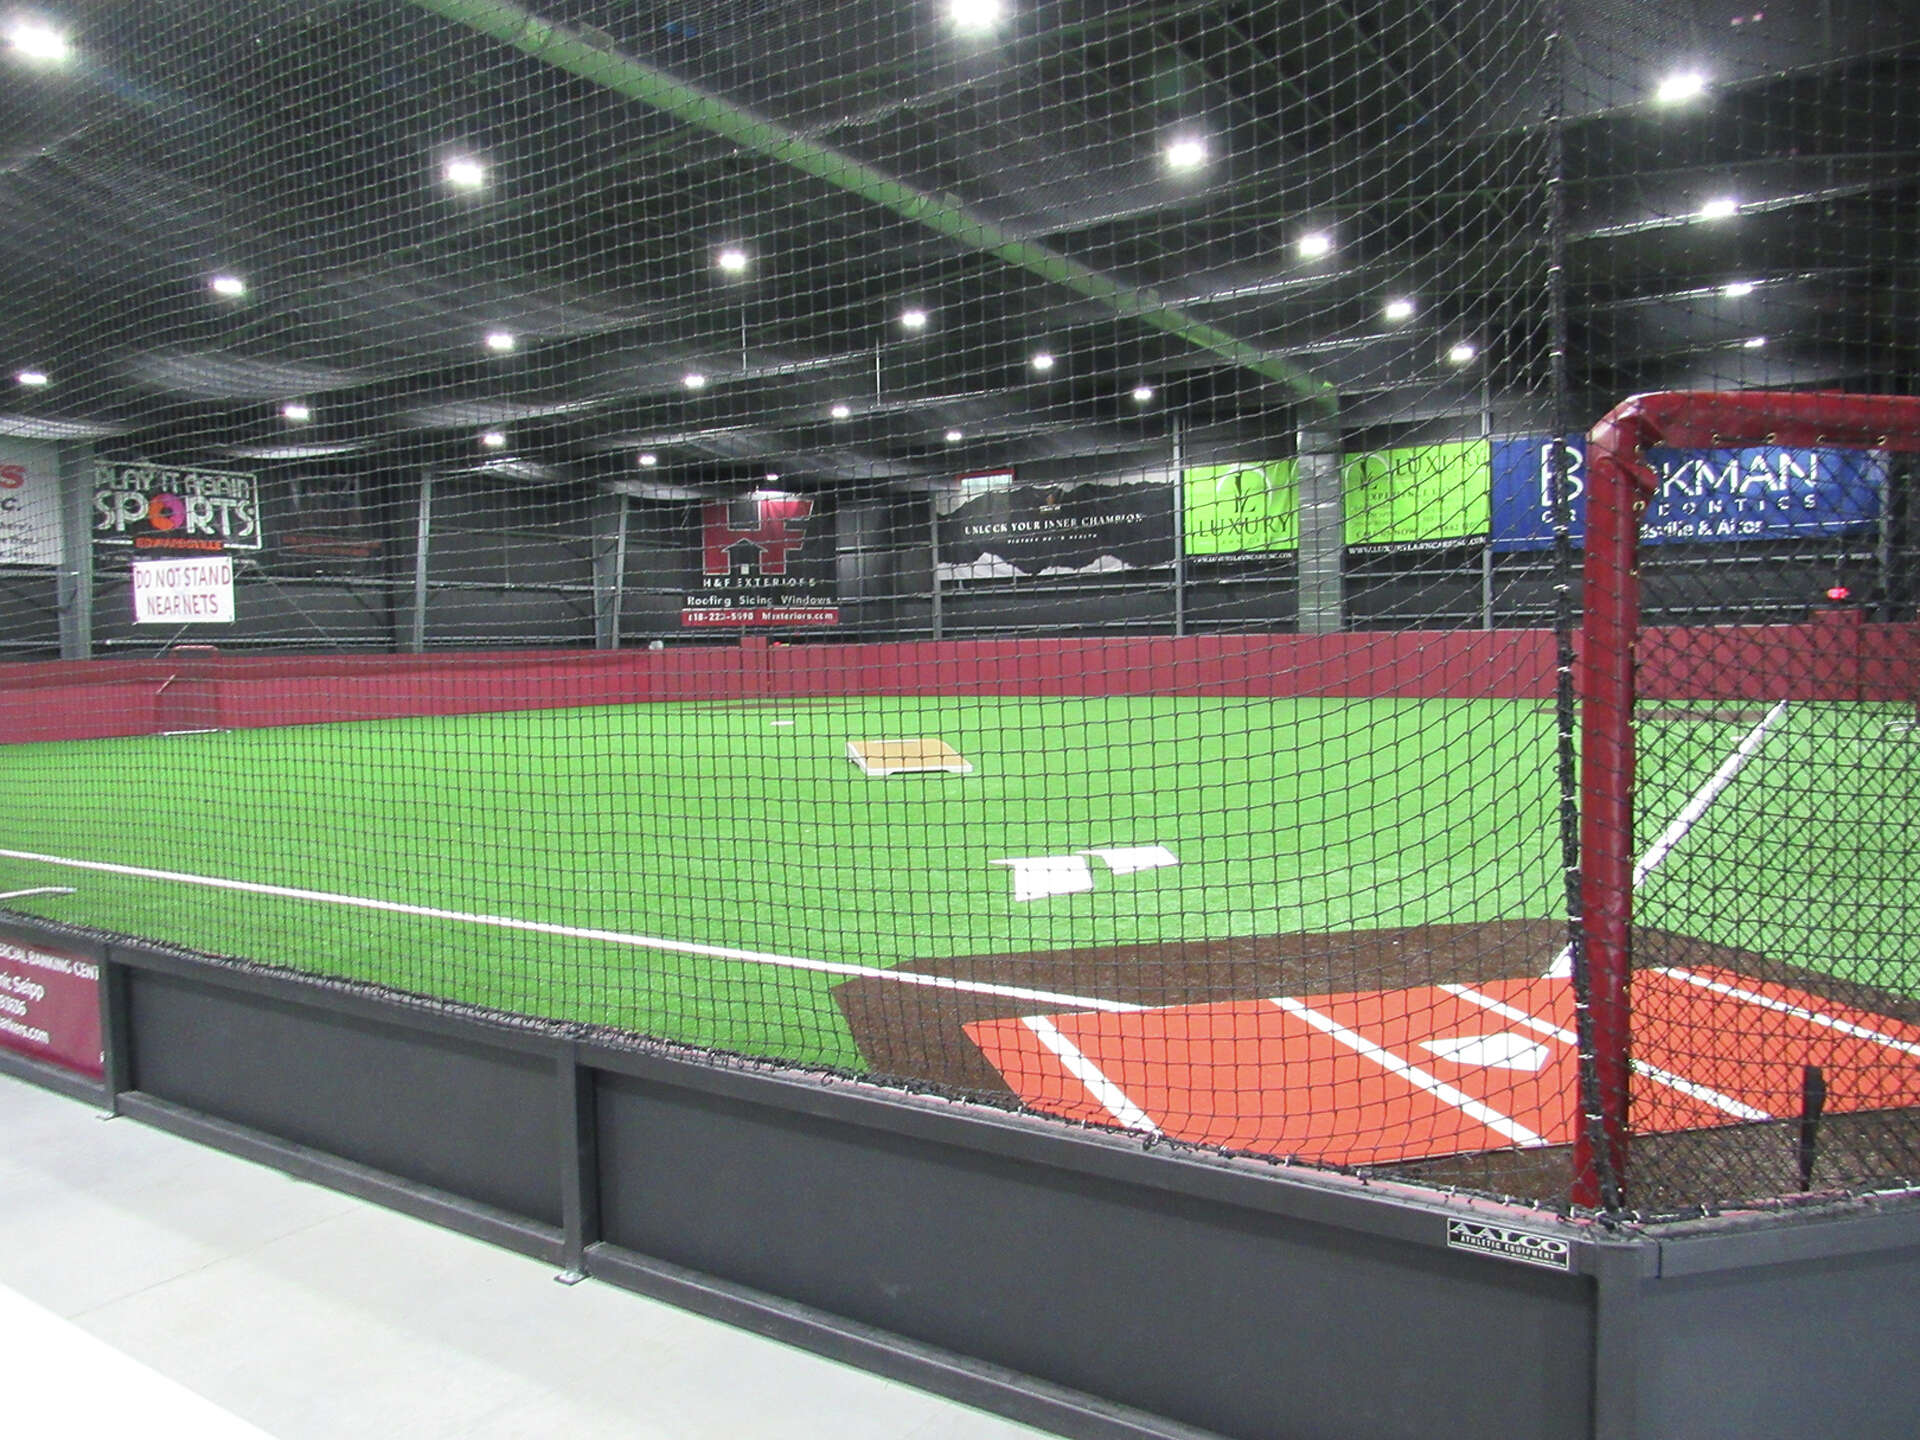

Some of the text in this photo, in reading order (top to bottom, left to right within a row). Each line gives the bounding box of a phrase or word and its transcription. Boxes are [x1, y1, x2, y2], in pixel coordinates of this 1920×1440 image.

[95, 466, 153, 491] PLAY
[184, 472, 250, 499] AGAIN
[1541, 443, 1818, 507] BKMAN
[95, 490, 254, 537] SPORTS
[964, 512, 1144, 536] UNLOCK YOUR INNER CHAMPION
[1199, 514, 1290, 537] LUXURY
[136, 565, 231, 589] DO NOT STAND
[703, 577, 817, 588] H&F EXTERIORS
[147, 593, 219, 616] NEAR NETS
[687, 595, 731, 607] Roofing
[781, 594, 832, 605] Windows
[1449, 1221, 1568, 1254] AALCO
[1460, 1234, 1501, 1250] ATHLETIC
[1504, 1243, 1555, 1260] EQUIPMENT
